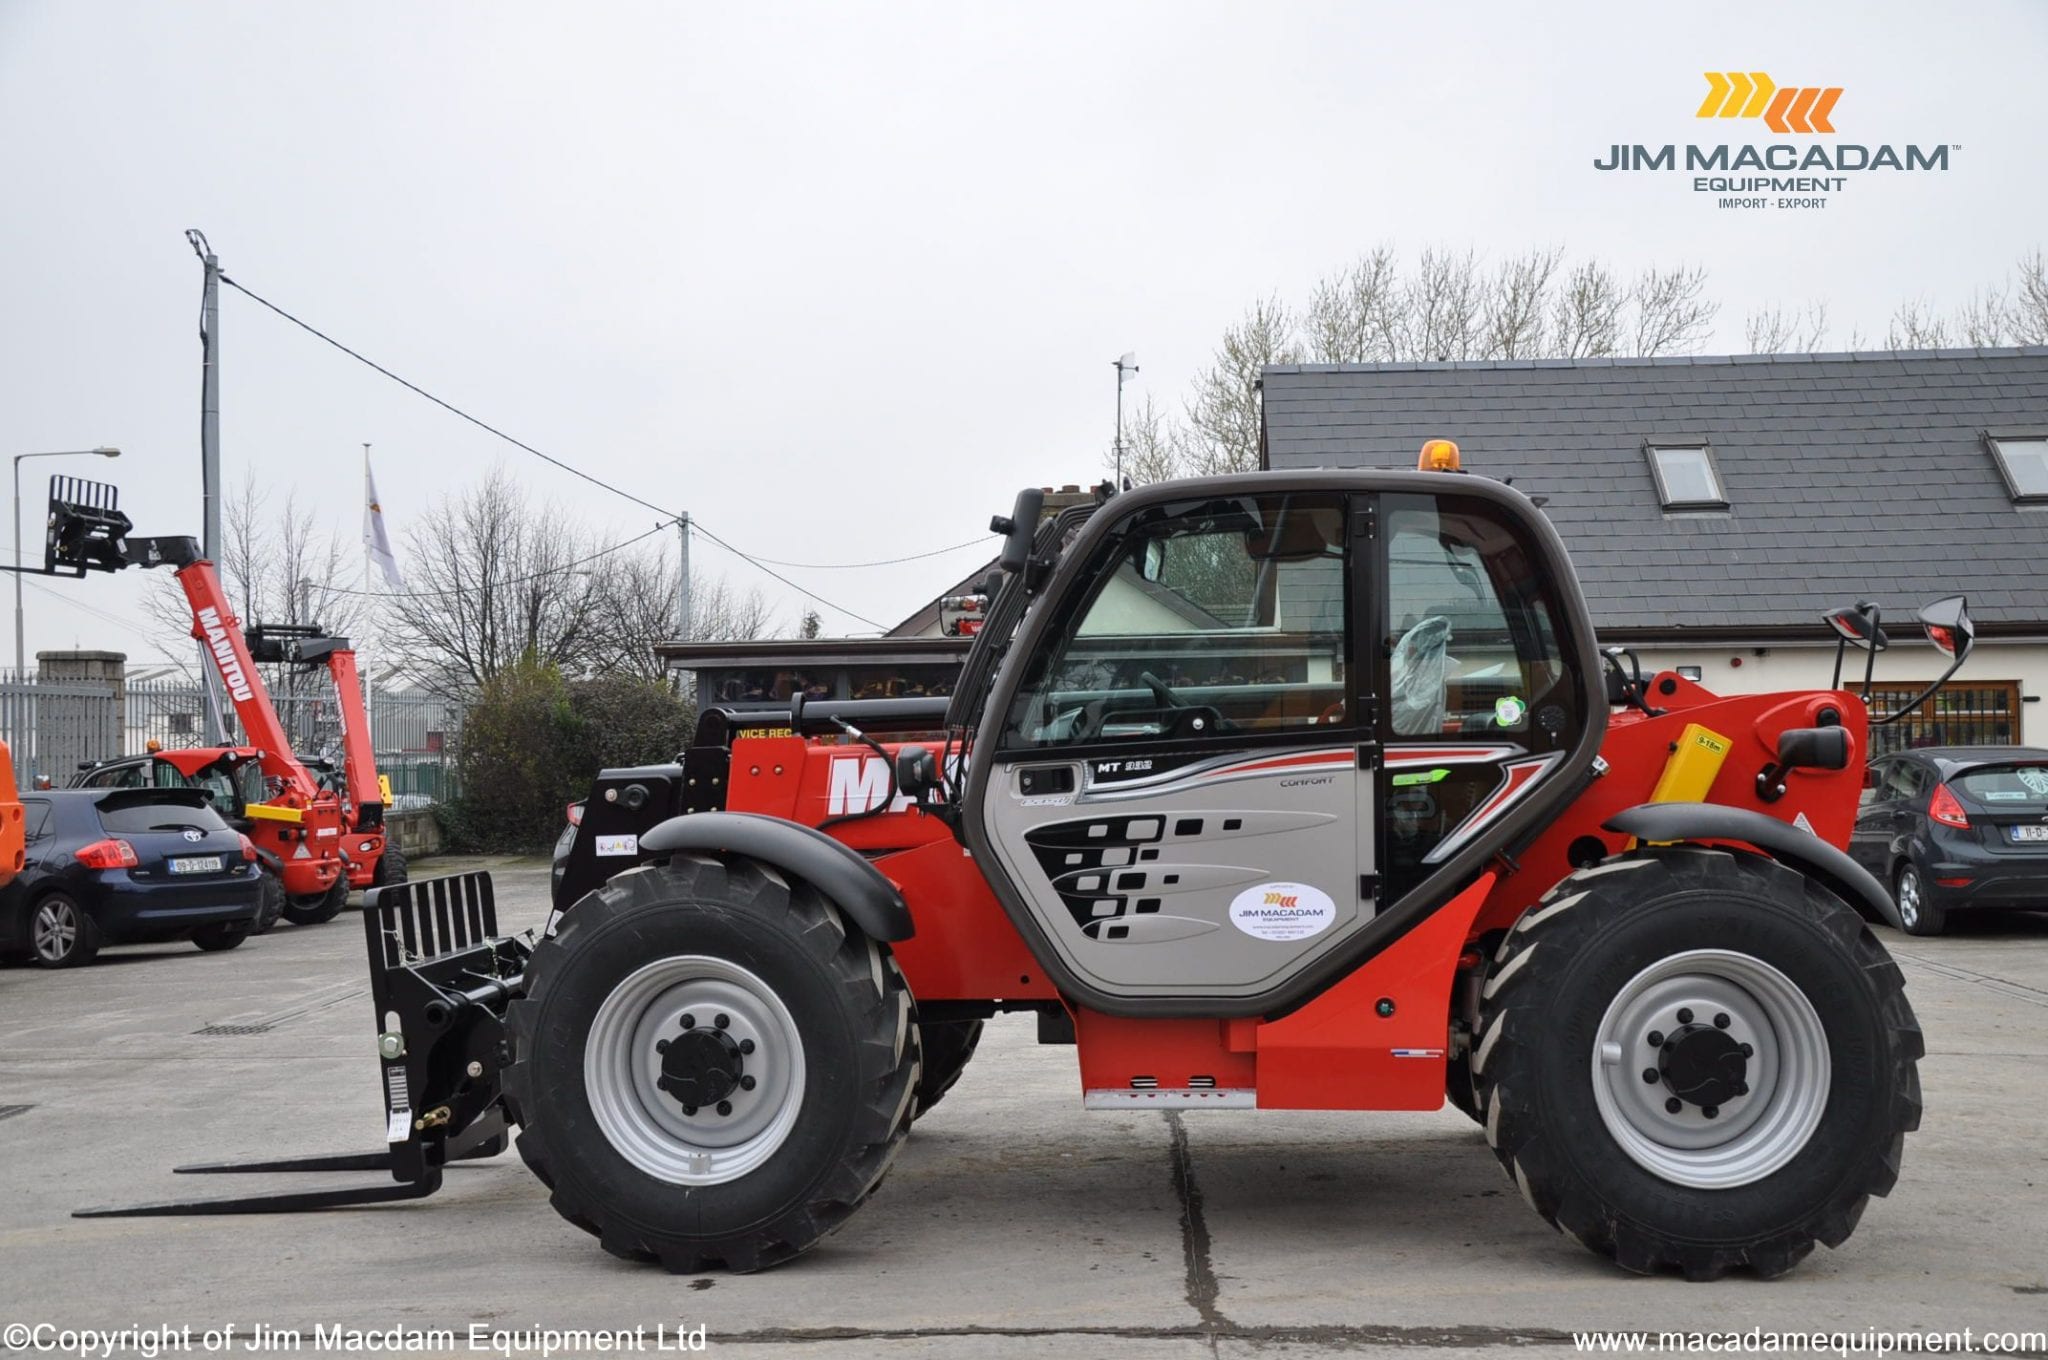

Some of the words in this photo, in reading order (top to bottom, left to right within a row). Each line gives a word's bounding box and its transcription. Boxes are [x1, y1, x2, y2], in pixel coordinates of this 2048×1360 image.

[197, 605, 254, 703] MANITOU
[1097, 762, 1121, 774] MT
[1279, 775, 1336, 788] COMFORT
[1238, 909, 1259, 918] JIM
[1260, 908, 1324, 917] MACADAM
